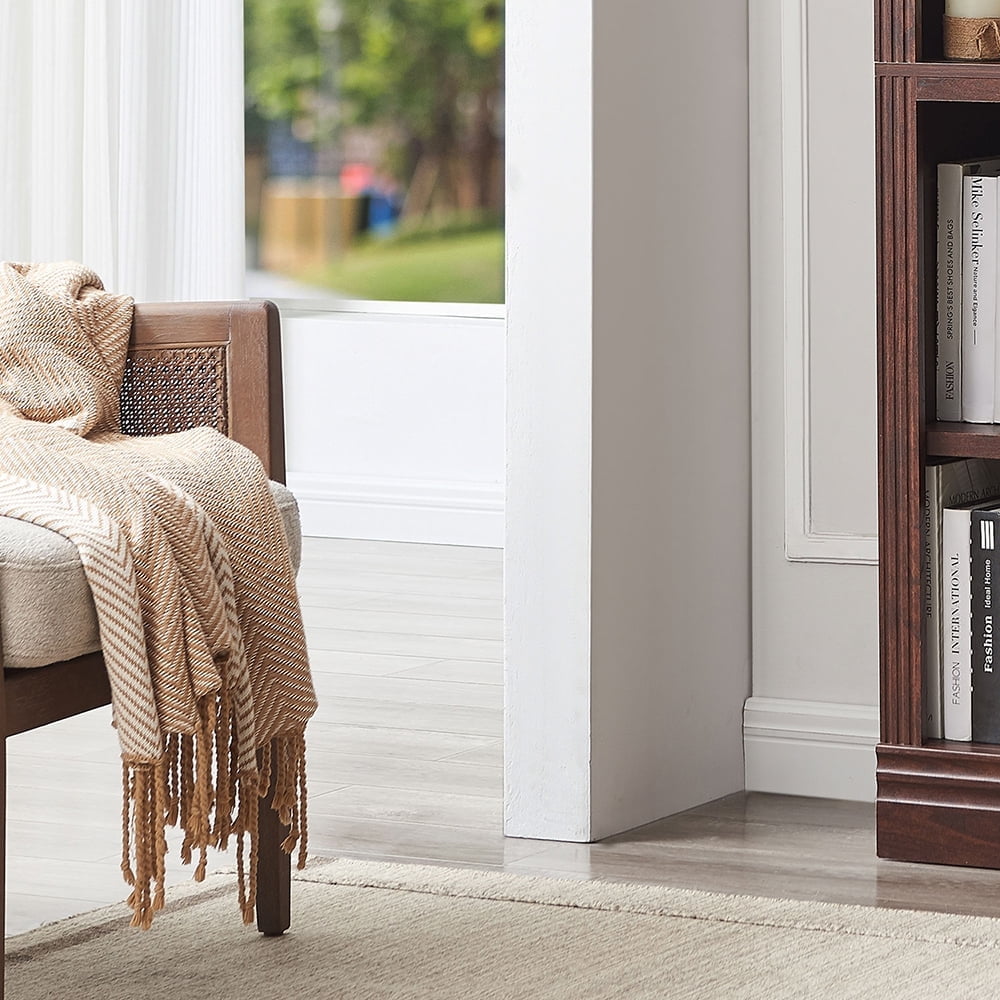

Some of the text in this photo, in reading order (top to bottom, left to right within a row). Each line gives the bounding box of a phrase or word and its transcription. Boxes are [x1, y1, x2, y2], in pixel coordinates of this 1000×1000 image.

[971, 177, 983, 265] Mike Selinker
[945, 361, 954, 400] FASHION
[951, 553, 961, 706] FASHION INTERNATIONAL
[983, 615, 993, 673] Fashion
